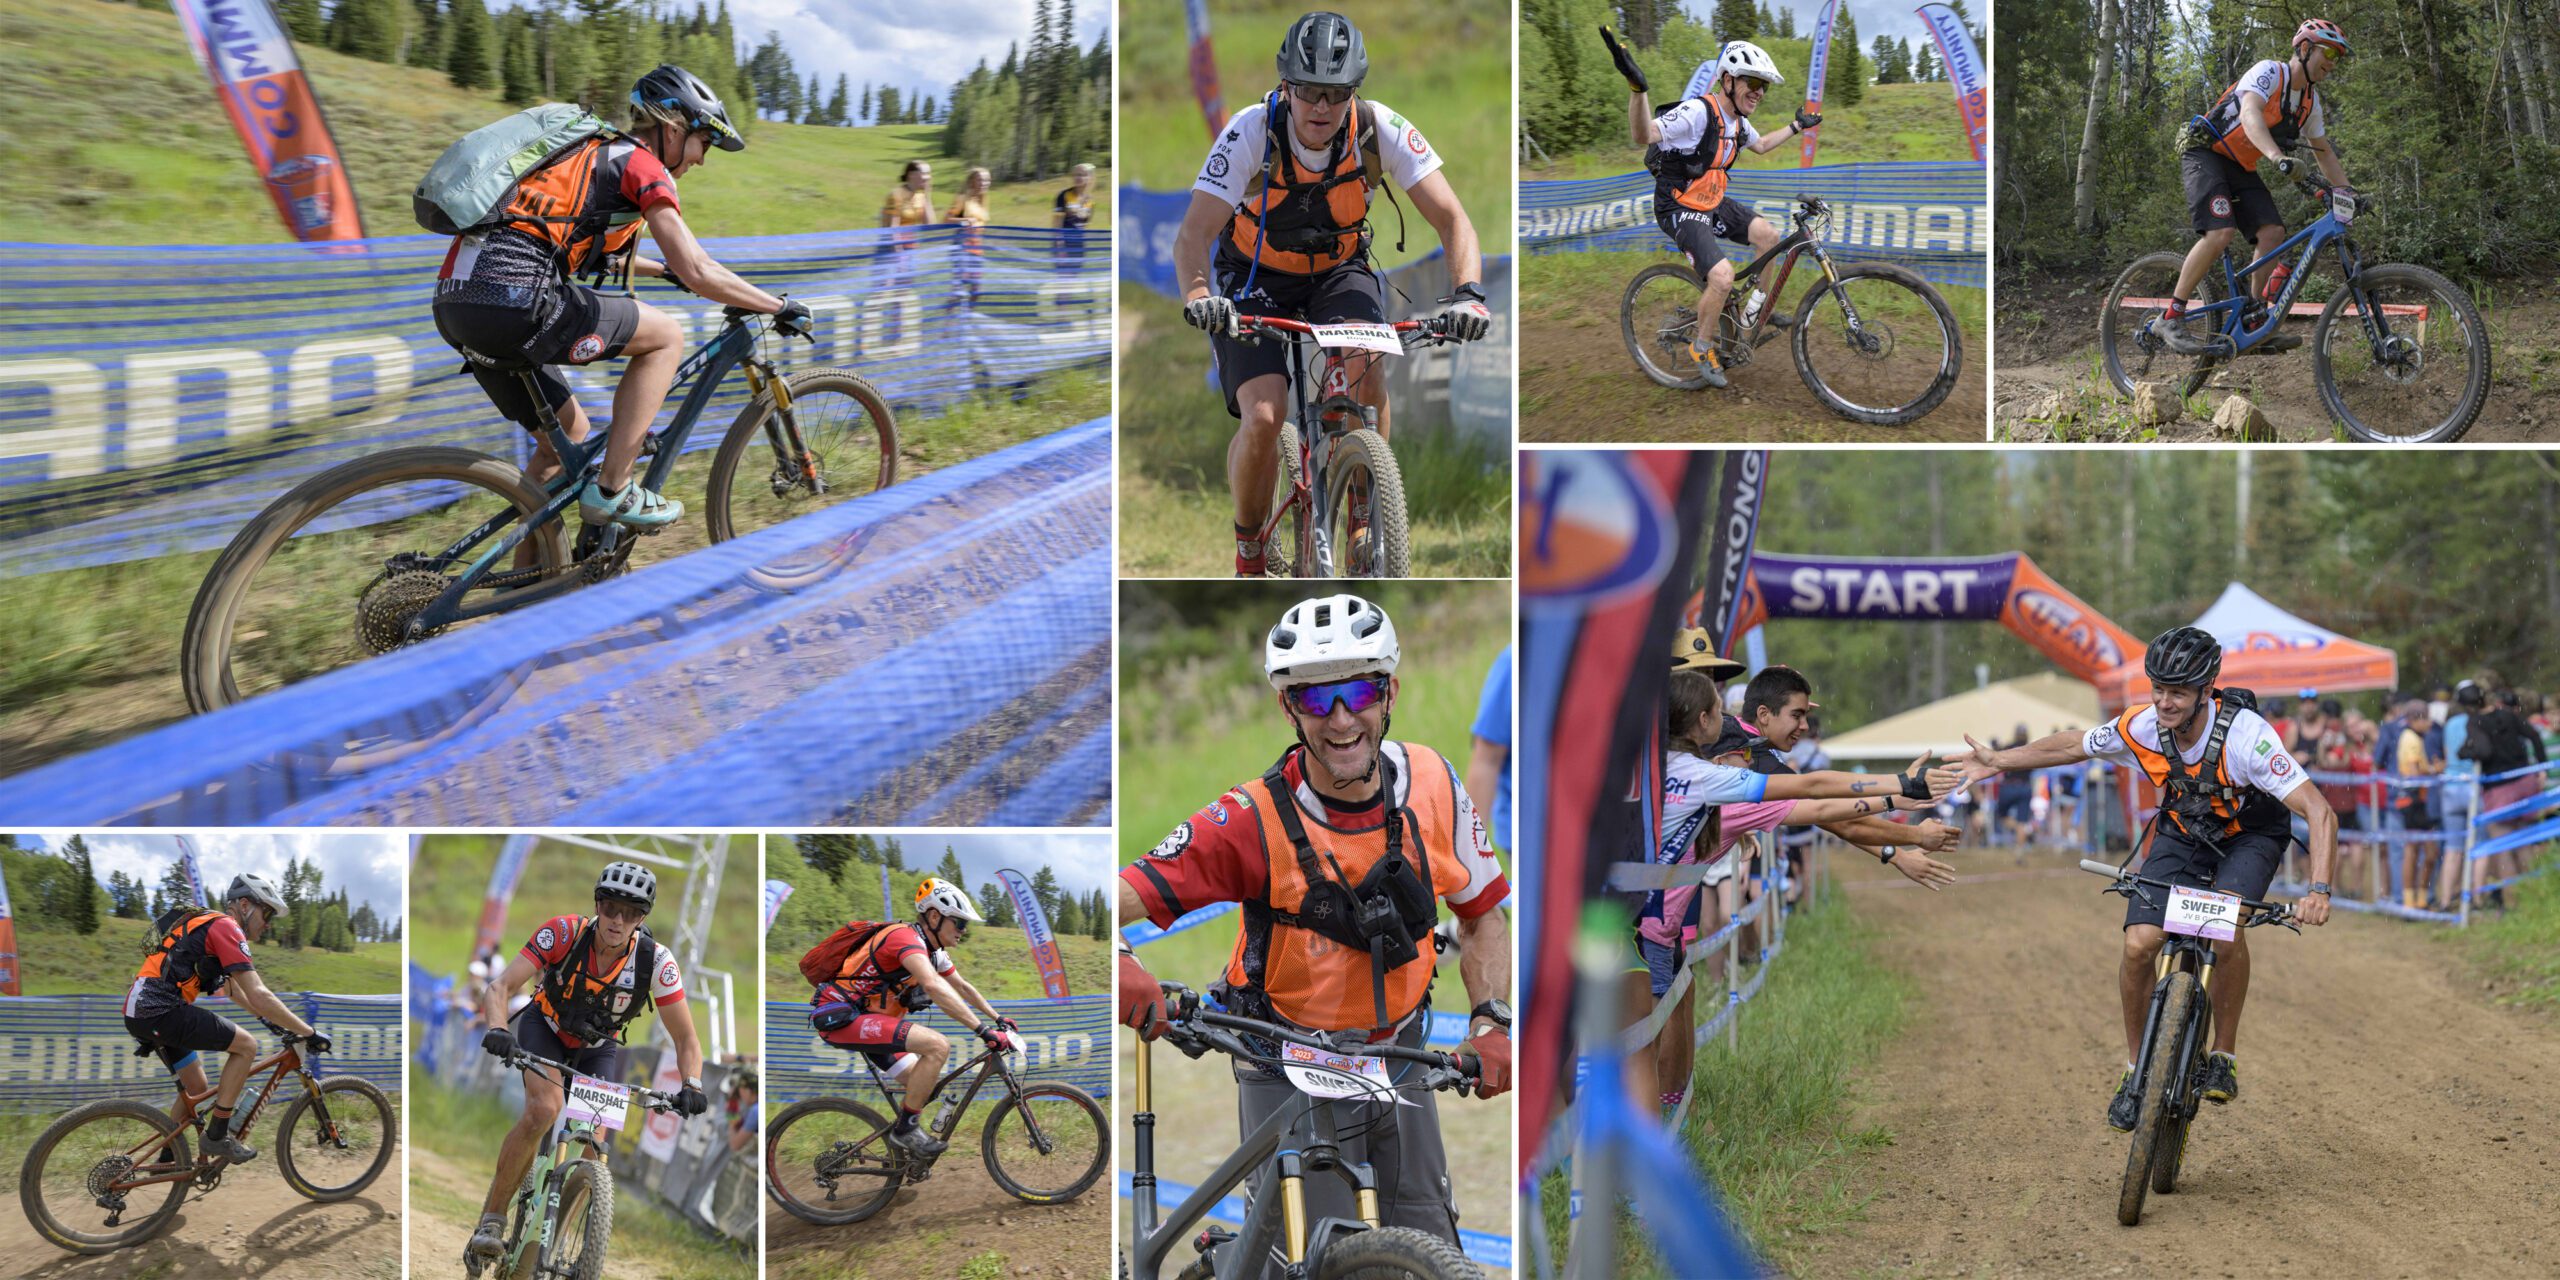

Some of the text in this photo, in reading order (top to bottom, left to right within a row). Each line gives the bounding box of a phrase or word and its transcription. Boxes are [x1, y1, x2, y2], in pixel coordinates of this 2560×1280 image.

[206, 0, 299, 139] COMM
[1936, 13, 1986, 119] COMMUNITY
[1218, 143, 1233, 155] FOX
[2273, 243, 2317, 321] SANTA CRUZ
[1318, 329, 1396, 341] MARSHAL
[1790, 568, 1979, 613] START
[1011, 879, 1054, 965] COMMUNITY
[2181, 899, 2227, 916] SWEEP
[1294, 1049, 1312, 1059] 2023
[573, 1086, 626, 1110] MARSHAL
